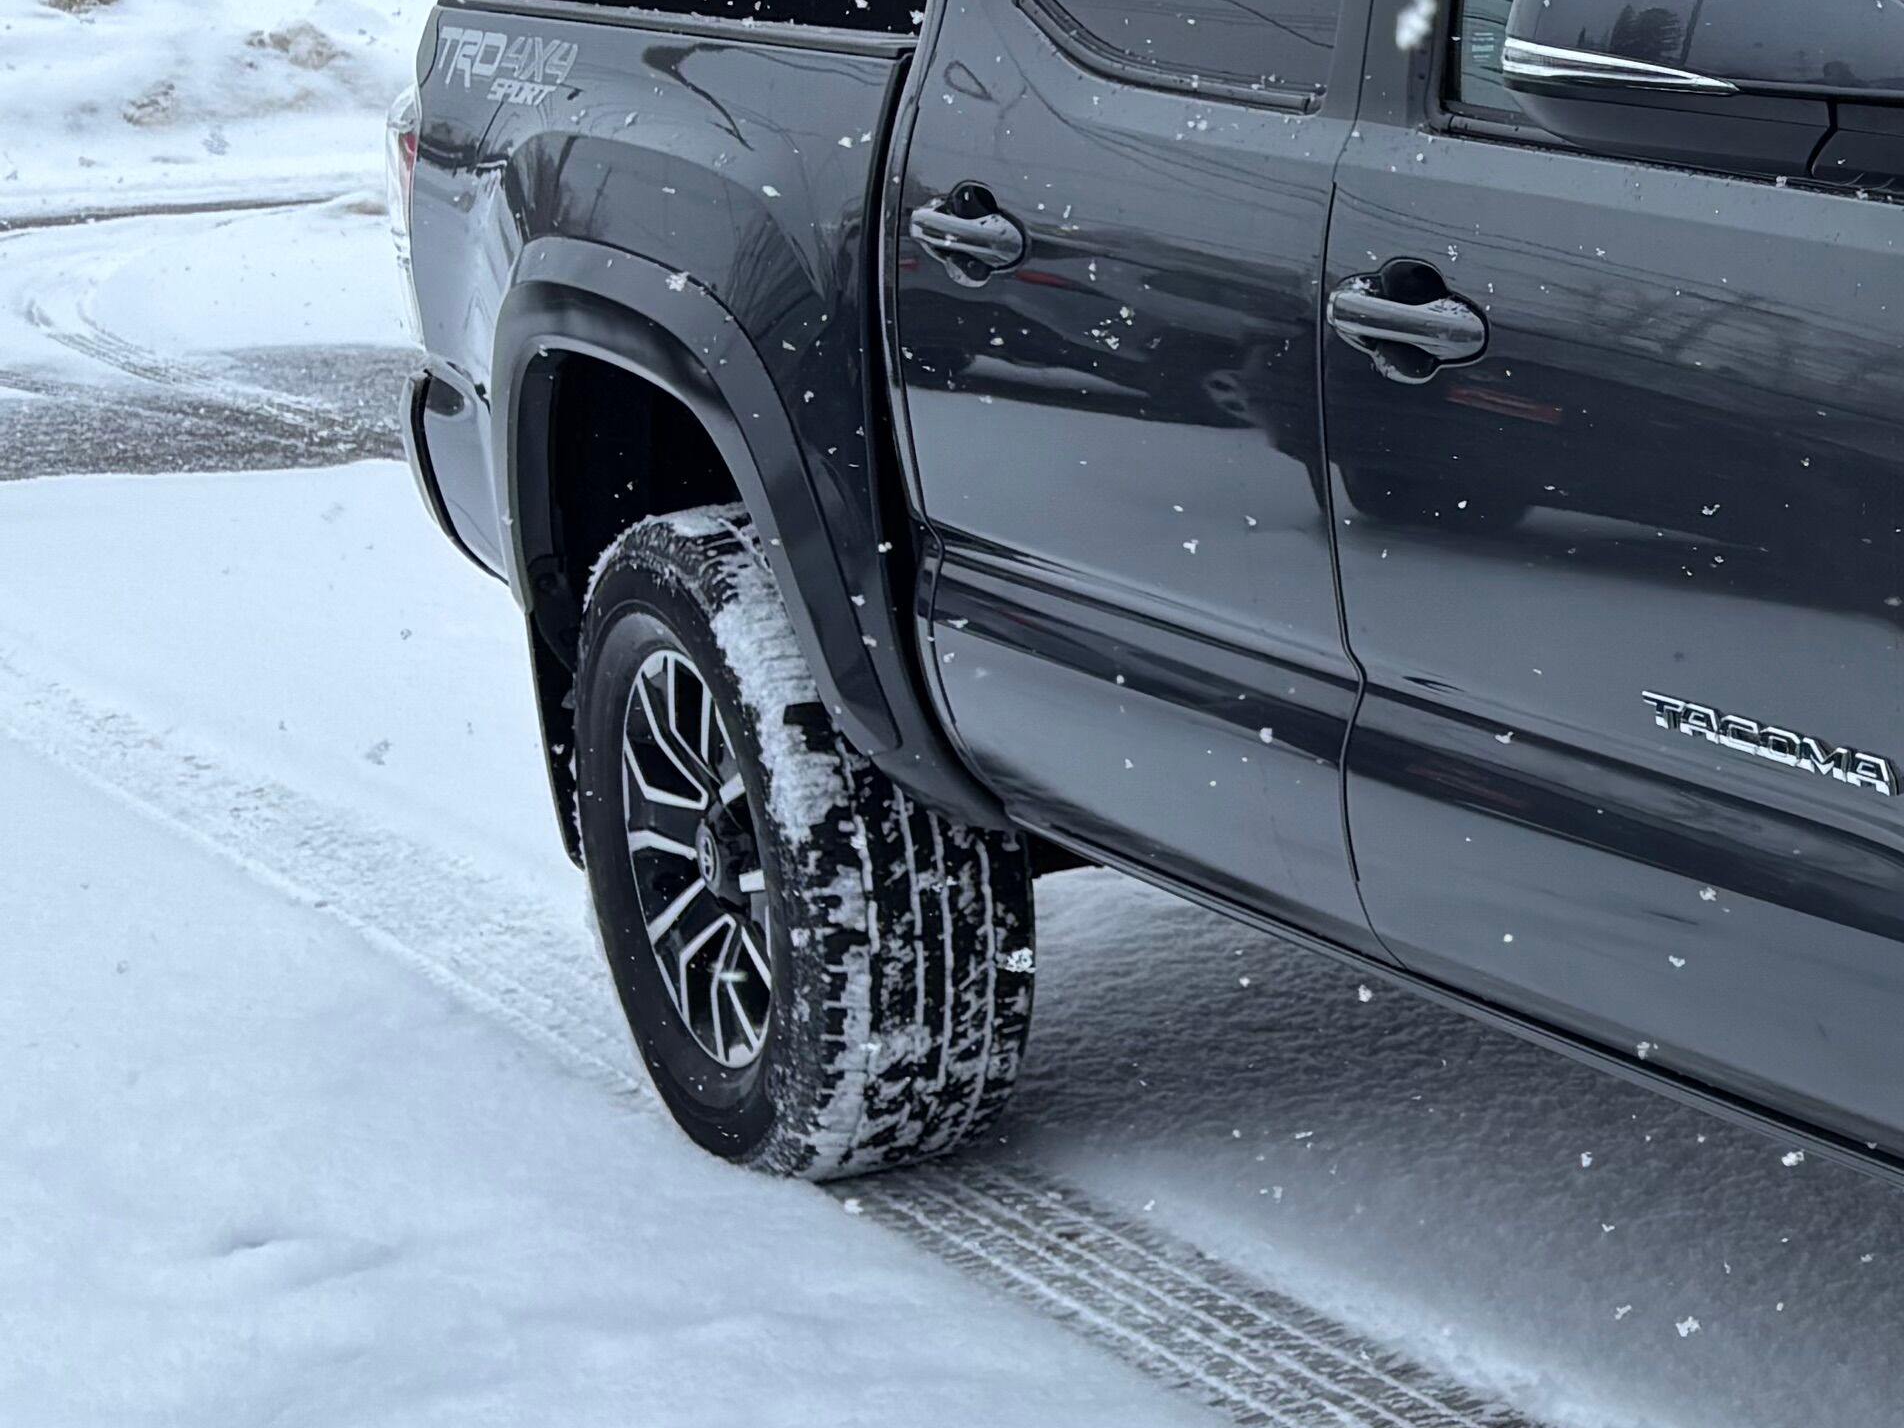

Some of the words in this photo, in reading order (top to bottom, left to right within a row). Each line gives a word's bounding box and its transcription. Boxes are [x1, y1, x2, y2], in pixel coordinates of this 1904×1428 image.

[436, 25, 508, 89] TRD
[501, 35, 579, 84] 4X4
[486, 77, 557, 107] SPORT
[1641, 689, 1904, 797] TACOMA
